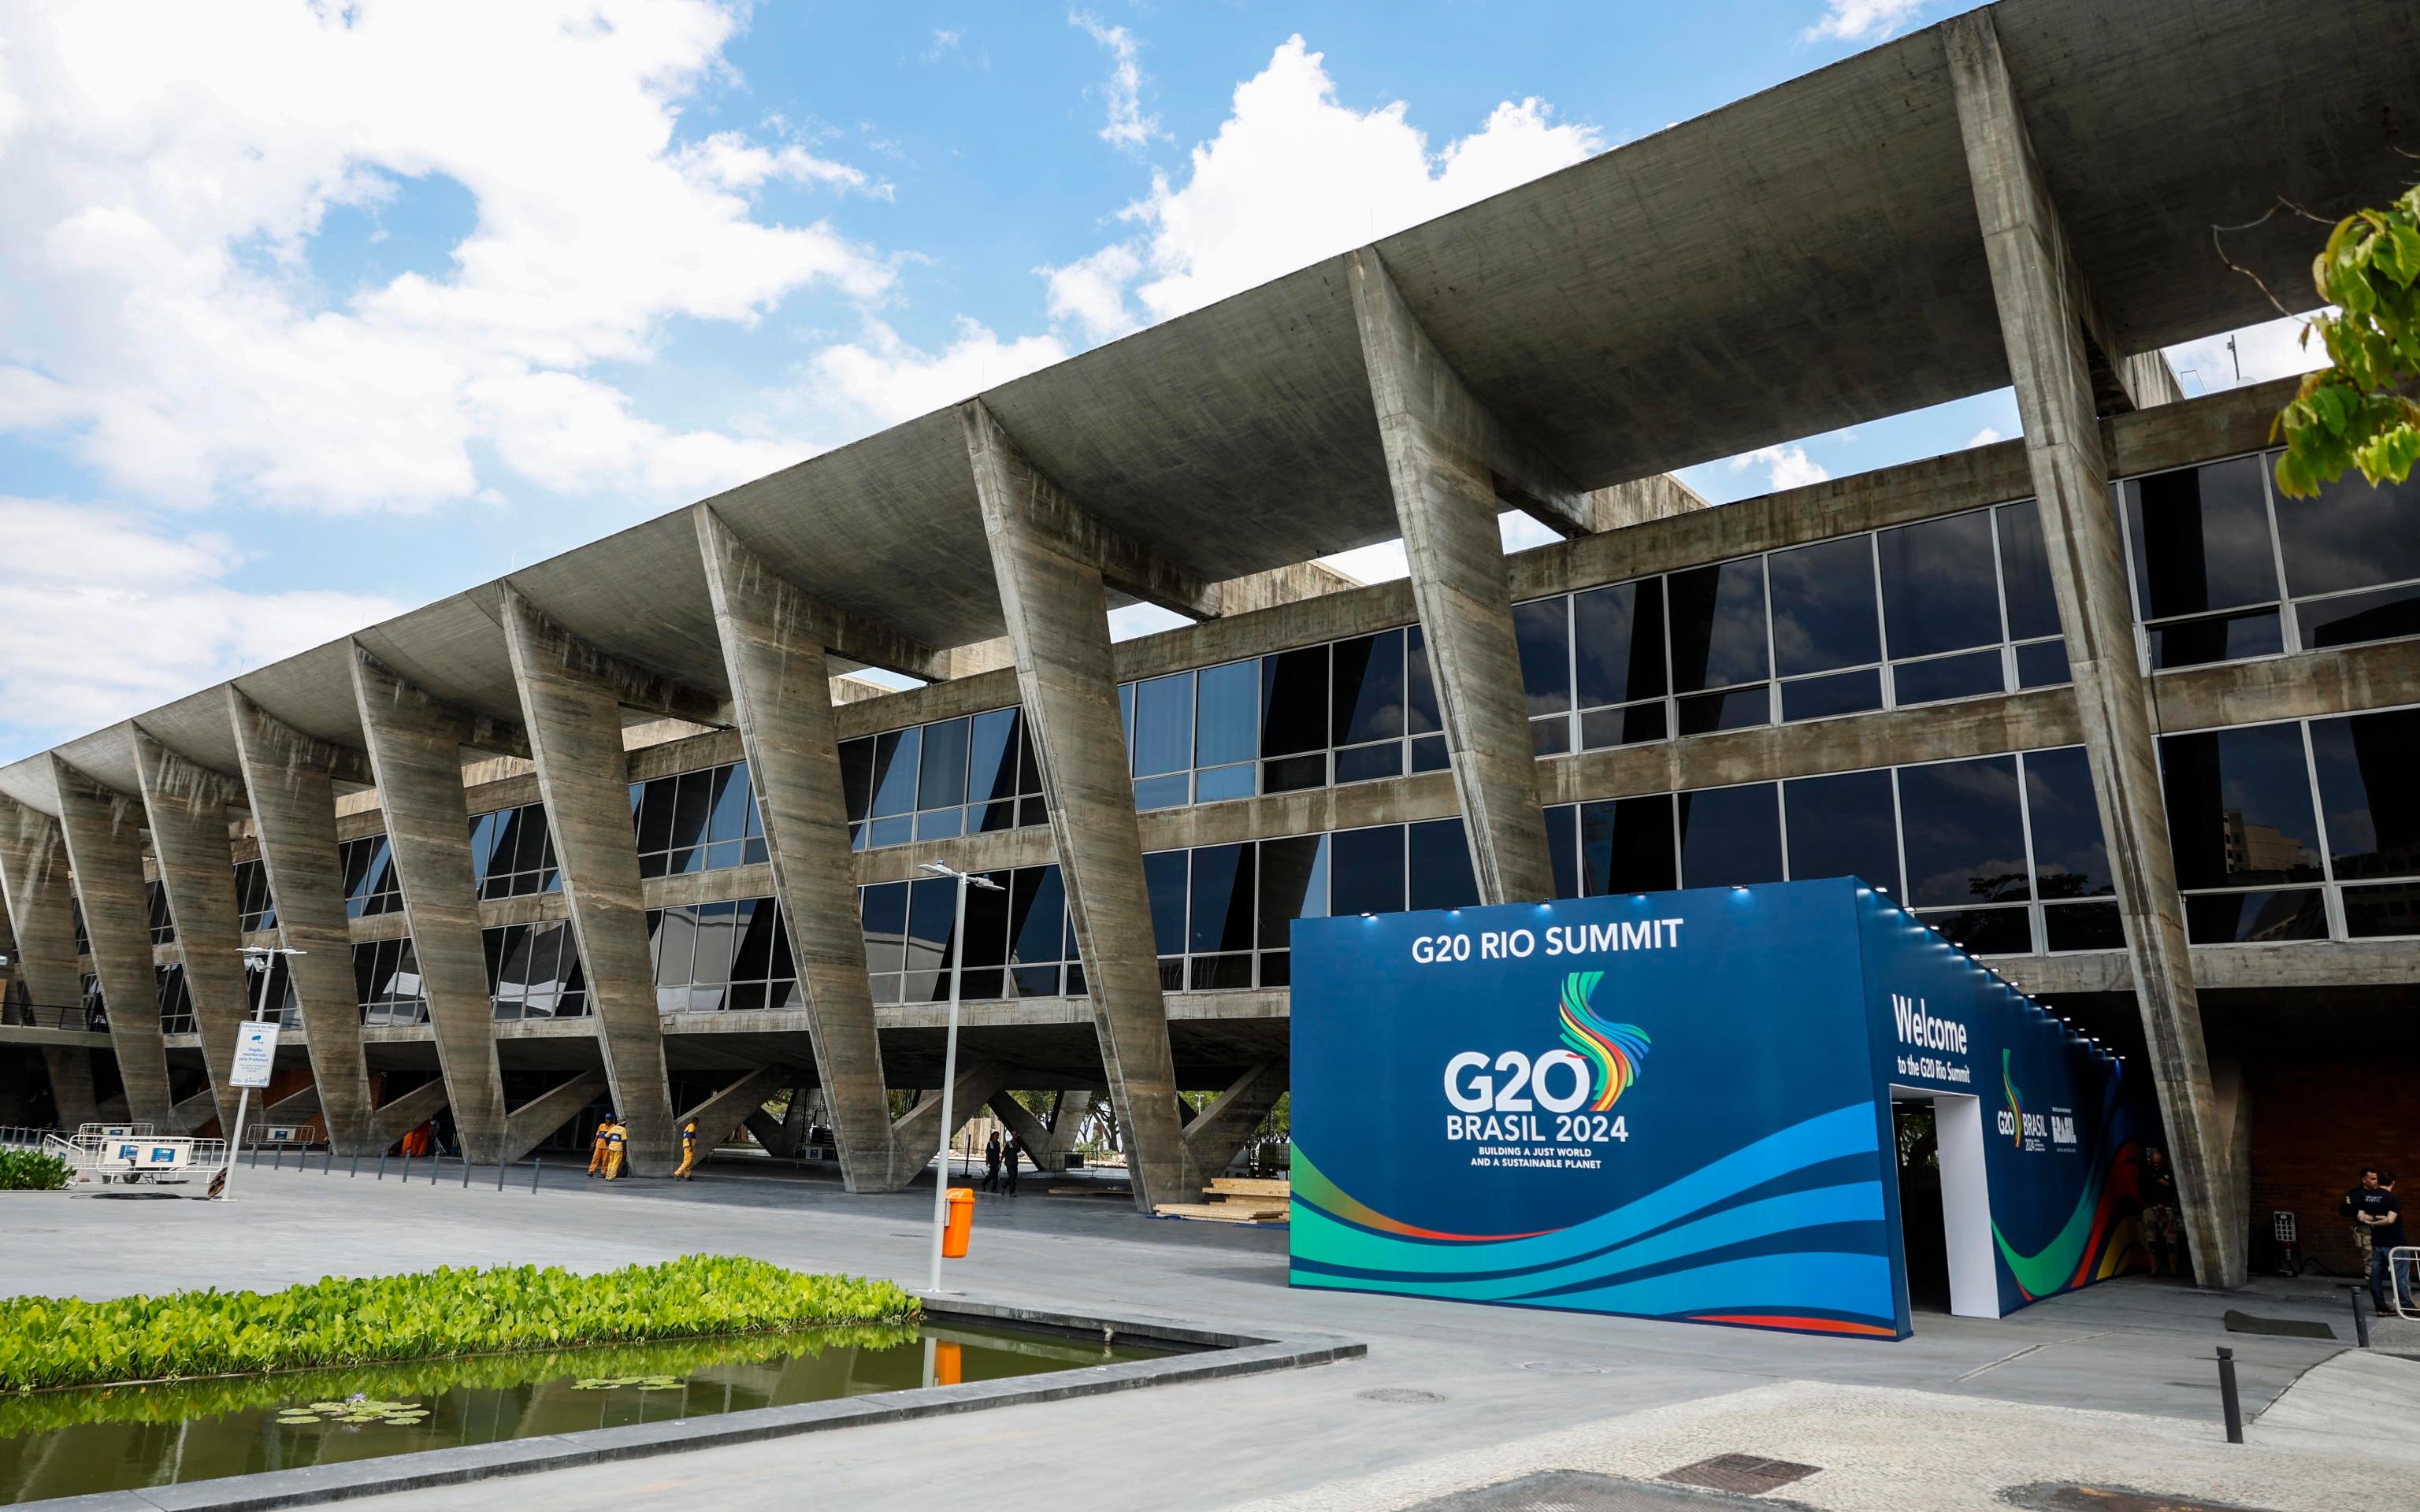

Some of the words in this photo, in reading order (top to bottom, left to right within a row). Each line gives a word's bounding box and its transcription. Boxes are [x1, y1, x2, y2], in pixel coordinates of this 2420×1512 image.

[1412, 935, 1471, 964] G20
[1481, 928, 1535, 960] RIO
[1546, 918, 1684, 956] SUMMIT
[1891, 993, 1968, 1054] Welcome
[1443, 1049, 1590, 1114] G20
[1897, 1055, 1906, 1074] to
[1907, 1054, 1920, 1077] the
[1920, 1057, 1935, 1079] G20
[1935, 1059, 1947, 1080] Rio
[1947, 1061, 1971, 1084] Summit
[1446, 1114, 1546, 1142] BRASIL
[1556, 1115, 1629, 1143] 2024
[1998, 1110, 2015, 1136] G20
[2022, 1113, 2047, 1137] BRASIL
[1471, 1158, 1491, 1166] AND
[1501, 1158, 1563, 1168] SUSTAINABLE
[1564, 1160, 1602, 1169] PLANET
[1479, 1147, 1521, 1156] BUILDING
[1524, 1147, 1531, 1156] A
[1533, 1148, 1555, 1157] JUST
[1557, 1148, 1592, 1158] WORLD
